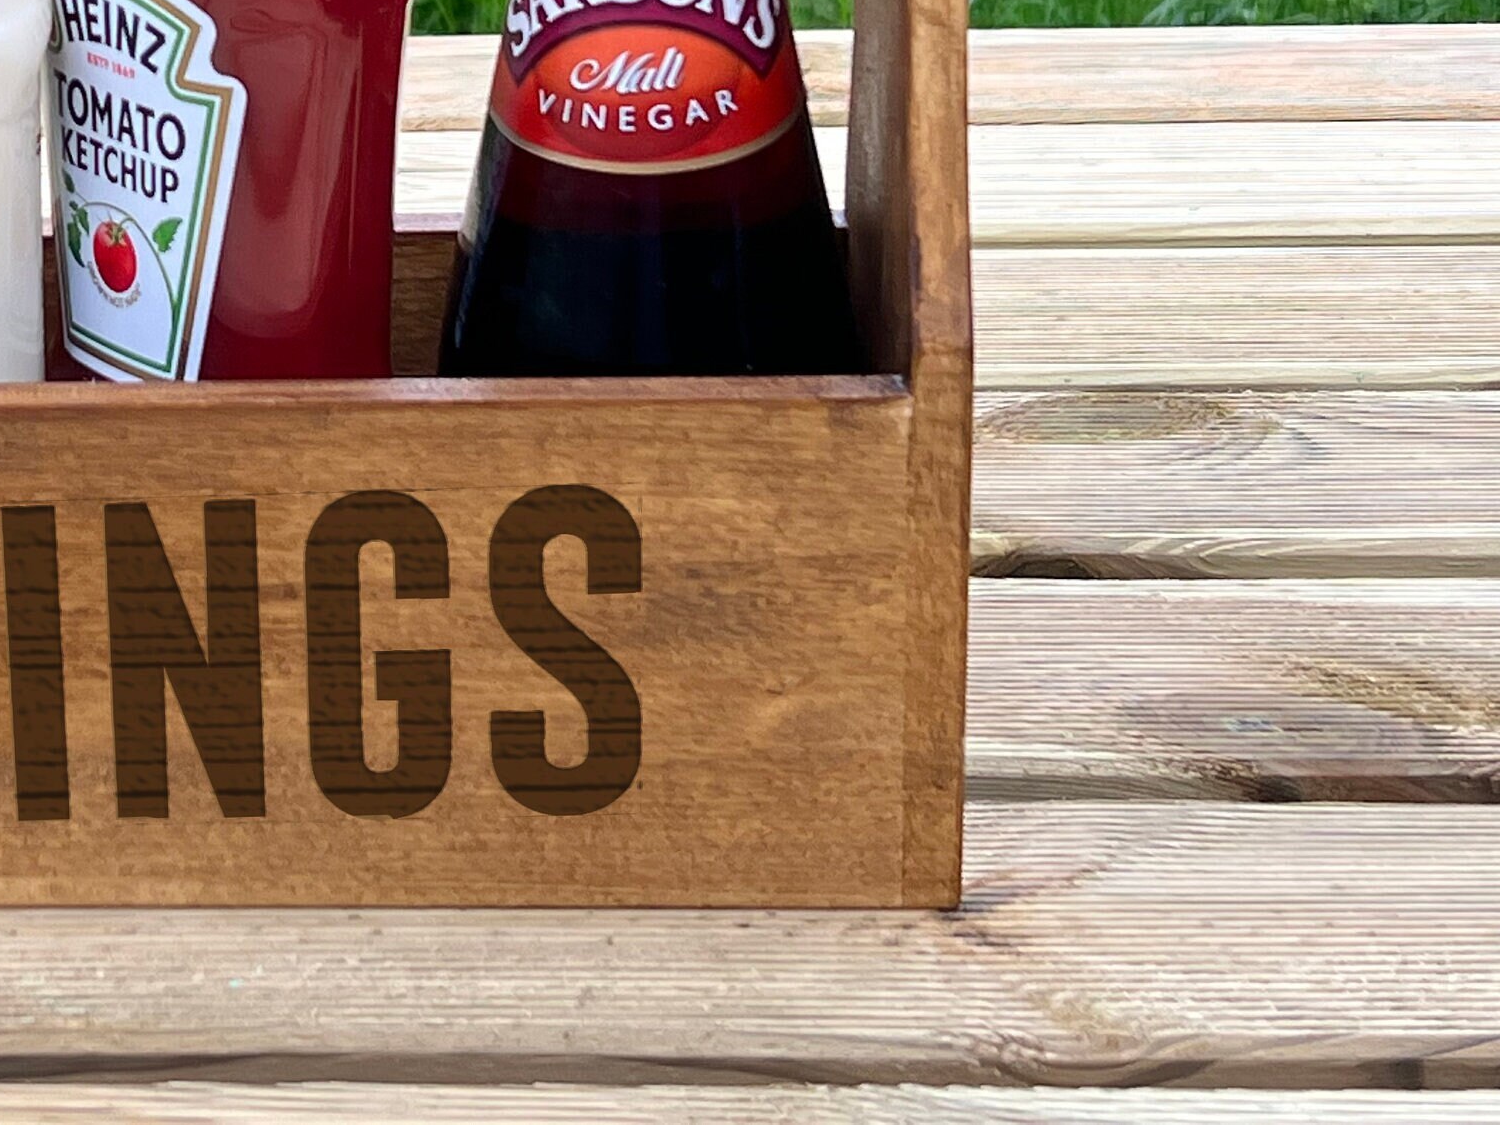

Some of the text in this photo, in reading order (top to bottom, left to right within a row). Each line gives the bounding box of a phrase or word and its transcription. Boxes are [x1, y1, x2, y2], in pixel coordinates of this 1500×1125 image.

[53, 68, 186, 161] TOMATO
[537, 87, 740, 133] VINEGAR
[61, 124, 180, 204] KETCHUP
